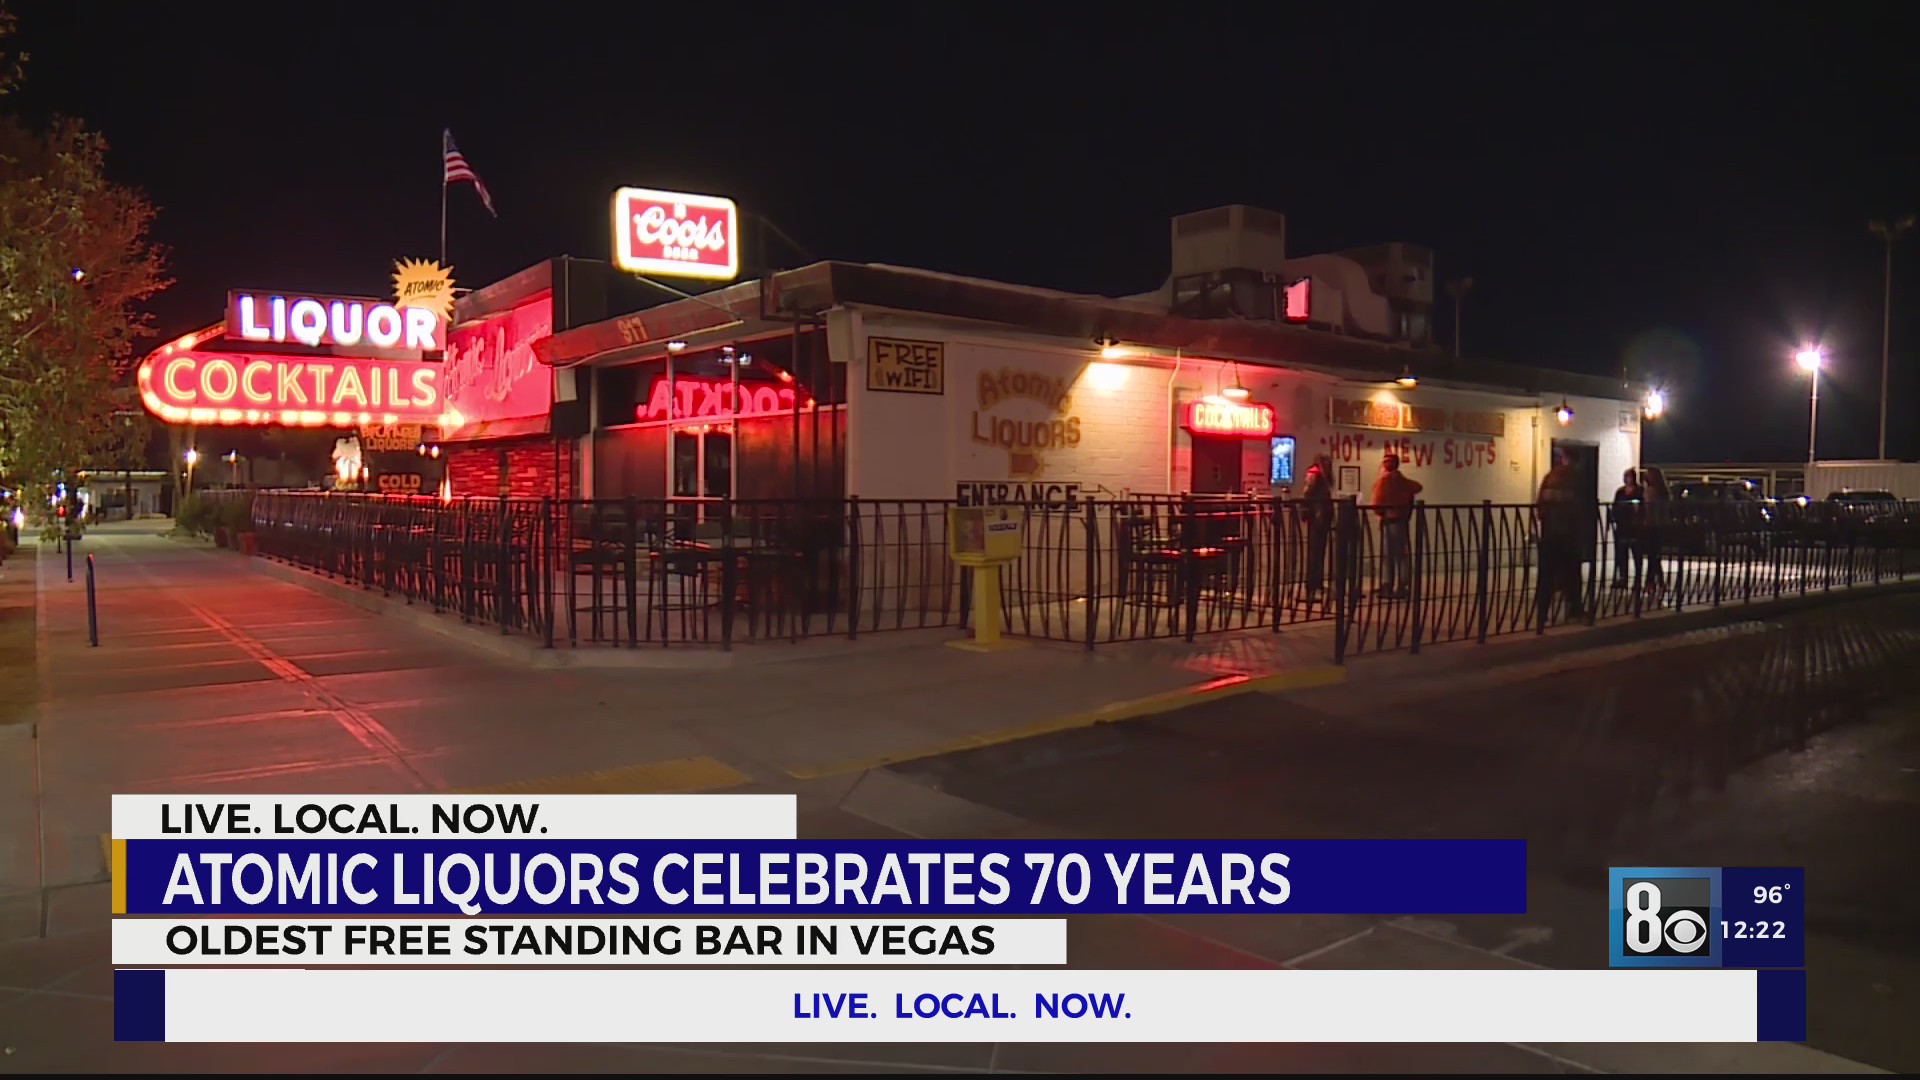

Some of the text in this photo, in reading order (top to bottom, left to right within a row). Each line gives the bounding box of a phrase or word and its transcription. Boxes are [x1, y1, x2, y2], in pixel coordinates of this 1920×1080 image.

[633, 206, 725, 251] Coors
[404, 280, 444, 296] ATOMIC
[239, 294, 437, 348] LIQUOR
[875, 341, 938, 367] FREE
[164, 356, 437, 407] COCKTAILS
[972, 410, 1081, 448] LIQUORS
[1384, 437, 1434, 467] NEW
[1444, 438, 1496, 469] SLOTS
[378, 474, 421, 489] COLD
[957, 484, 1079, 510] ENTRANCE
